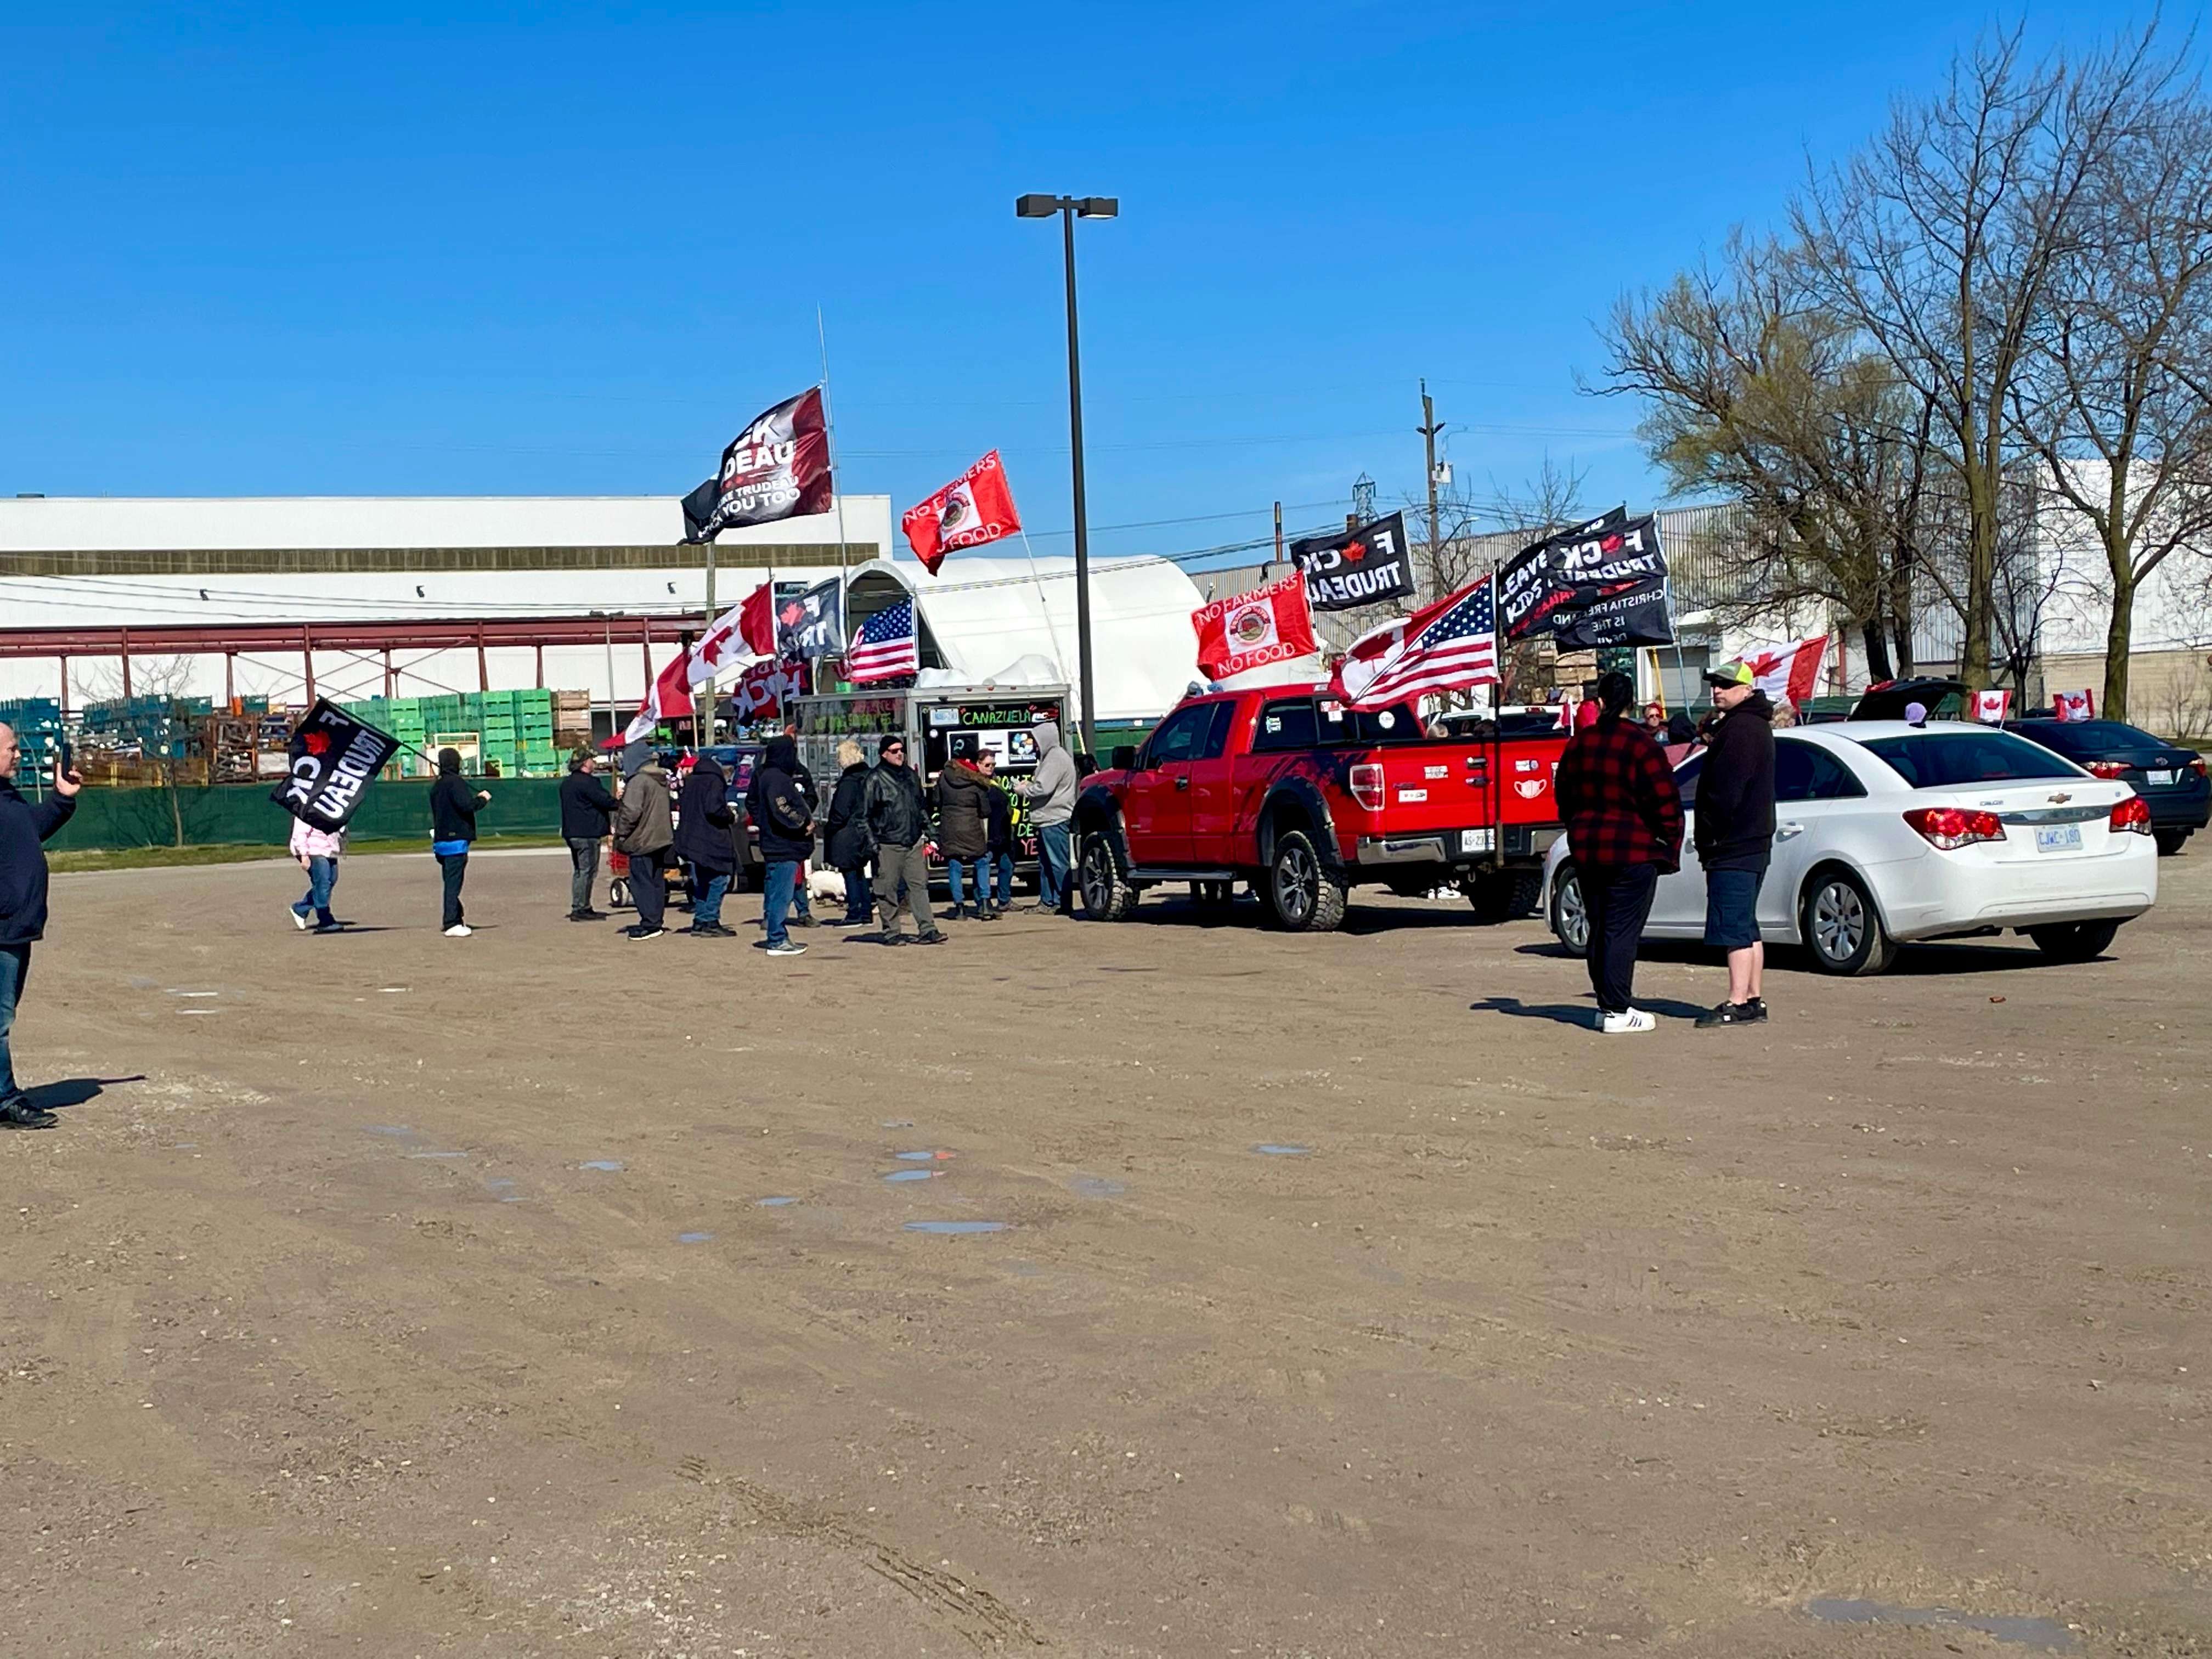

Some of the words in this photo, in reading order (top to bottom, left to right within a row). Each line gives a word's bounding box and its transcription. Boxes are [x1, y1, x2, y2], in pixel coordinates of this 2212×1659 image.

[724, 440, 796, 482] DEAU
[723, 496, 756, 516] YOU
[759, 488, 801, 507] TOO
[905, 507, 931, 525] NO
[949, 522, 1001, 550] FOOD
[1196, 604, 1222, 625] NO
[1223, 575, 1298, 612] FARMERS
[1506, 578, 1542, 624] KIDS
[1217, 657, 1243, 676] NO
[1246, 642, 1296, 665] FOOD
[962, 709, 1031, 725] CANAZUELA
